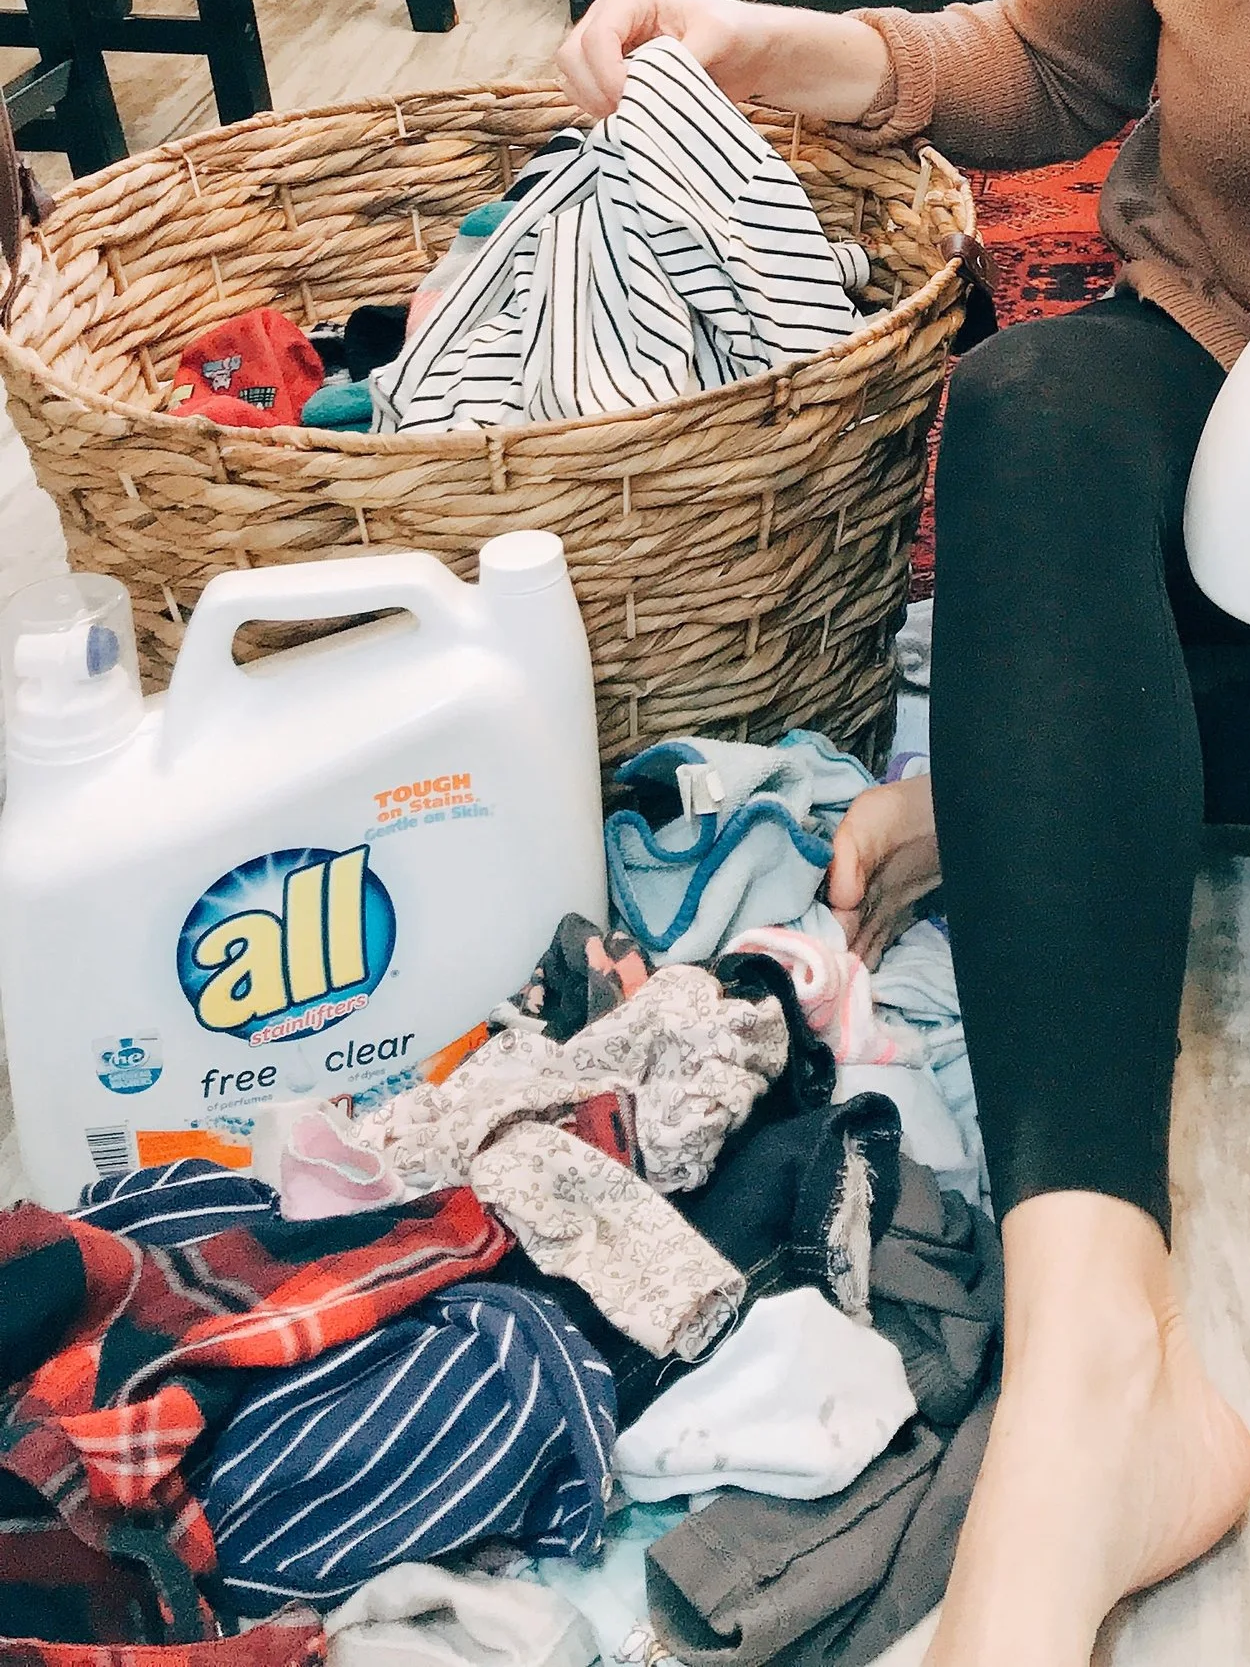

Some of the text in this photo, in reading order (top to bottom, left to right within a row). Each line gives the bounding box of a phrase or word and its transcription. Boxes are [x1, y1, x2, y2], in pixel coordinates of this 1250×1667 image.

[374, 773, 471, 808] TOUGH
[377, 793, 480, 822] on Stains.
[364, 817, 417, 841] Gentle
[424, 812, 445, 824] on
[192, 844, 370, 1032] all
[251, 995, 367, 1046] stainlifters
[201, 1033, 415, 1098] free clear
[348, 1068, 385, 1082] of dyes
[207, 1094, 273, 1112] of perfumes
